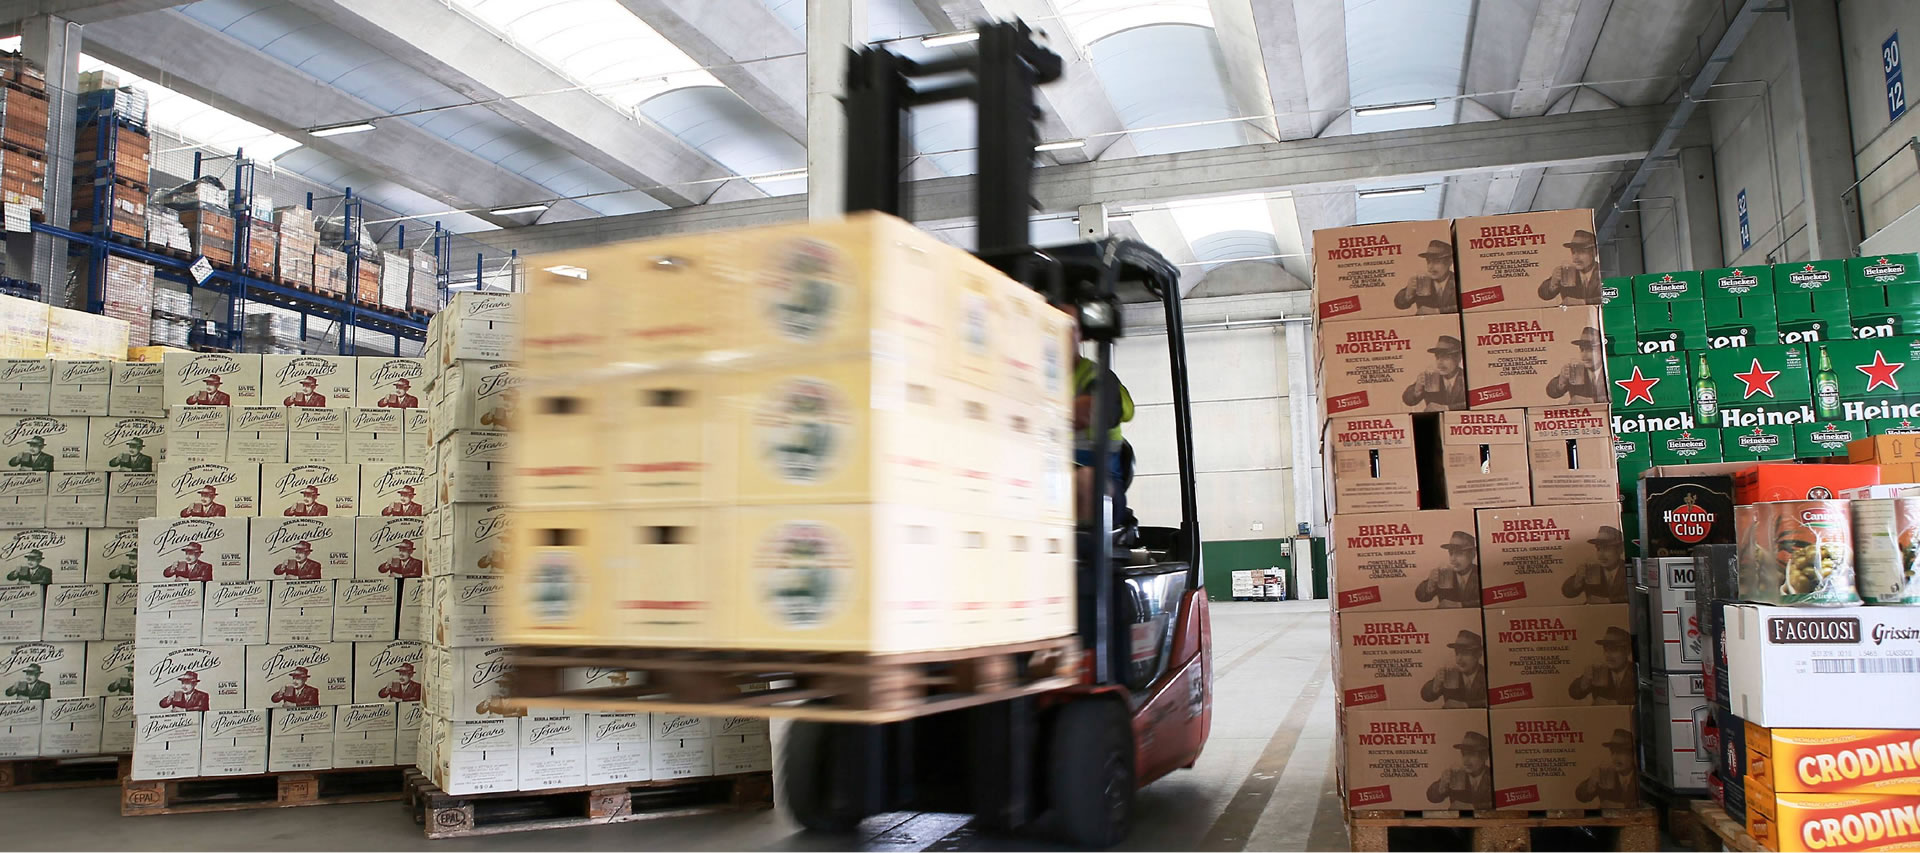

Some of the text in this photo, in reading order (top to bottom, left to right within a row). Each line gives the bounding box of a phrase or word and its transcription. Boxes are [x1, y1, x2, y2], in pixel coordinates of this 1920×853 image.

[1884, 41, 1898, 72] 30
[1889, 82, 1903, 111] 12
[1739, 195, 1746, 216] 32
[1481, 224, 1532, 237] BIRRA
[1741, 225, 1748, 244] 14
[1338, 235, 1389, 248] BIRRA
[1470, 234, 1546, 249] MORETTI
[1328, 245, 1402, 260] MORETTI
[1488, 321, 1541, 333] BIRRA
[1347, 330, 1398, 342] BIRRA
[1477, 331, 1554, 346] MORETTI
[1336, 340, 1411, 354] MORETTI
[178, 362, 241, 386] Piemontese
[176, 411, 222, 429] Piemontese
[237, 411, 282, 429] Piemontese
[295, 411, 339, 430] Piemontese
[353, 412, 396, 430] Piemontese
[1460, 414, 1507, 424] BIRRA
[1544, 408, 1591, 419] BIRRA
[1347, 419, 1393, 430] BIRRA
[1450, 425, 1518, 435] MORETTI
[1534, 418, 1603, 431] MORETTI
[1338, 430, 1405, 442] MORETTI
[1741, 437, 1776, 446] Heineken
[171, 472, 237, 499] Piemontese
[275, 472, 338, 498] Piemontese
[1663, 510, 1714, 522] Havana
[1359, 524, 1411, 536] BIRRA
[1503, 519, 1557, 531] BIRRA
[1675, 524, 1704, 535] Club
[154, 527, 224, 557] Piemontese
[265, 526, 333, 555] Piemontese
[1347, 535, 1424, 548] MORETTI
[1492, 530, 1570, 543] MORETTI
[145, 586, 196, 610] Piemontese
[212, 585, 262, 607] Piemontese
[279, 584, 327, 606] Piemontese
[343, 584, 391, 606] Piemontese
[1364, 622, 1417, 634] BIRRA
[1510, 618, 1564, 630] BIRRA
[1774, 620, 1854, 640] FAGOLOSI
[1353, 633, 1430, 646] MORETTI
[1498, 630, 1577, 643] MORETTI
[149, 656, 221, 687] Piemontese
[262, 651, 330, 682] Piemontese
[211, 713, 261, 736] Piemontese
[279, 711, 328, 733] Piemontese
[343, 709, 391, 729] Piemontese
[1516, 721, 1570, 732] BIRRA
[142, 718, 193, 741] Piemontese
[529, 724, 572, 745] Toscana
[597, 721, 637, 740] Toscana
[1370, 722, 1423, 733] BIRRA
[461, 728, 506, 748] Toscana
[1359, 734, 1436, 745] MORETTI
[1504, 732, 1584, 744] MORETTI
[440, 812, 460, 823] EPAL
[1803, 804, 1920, 849] CRODIN
